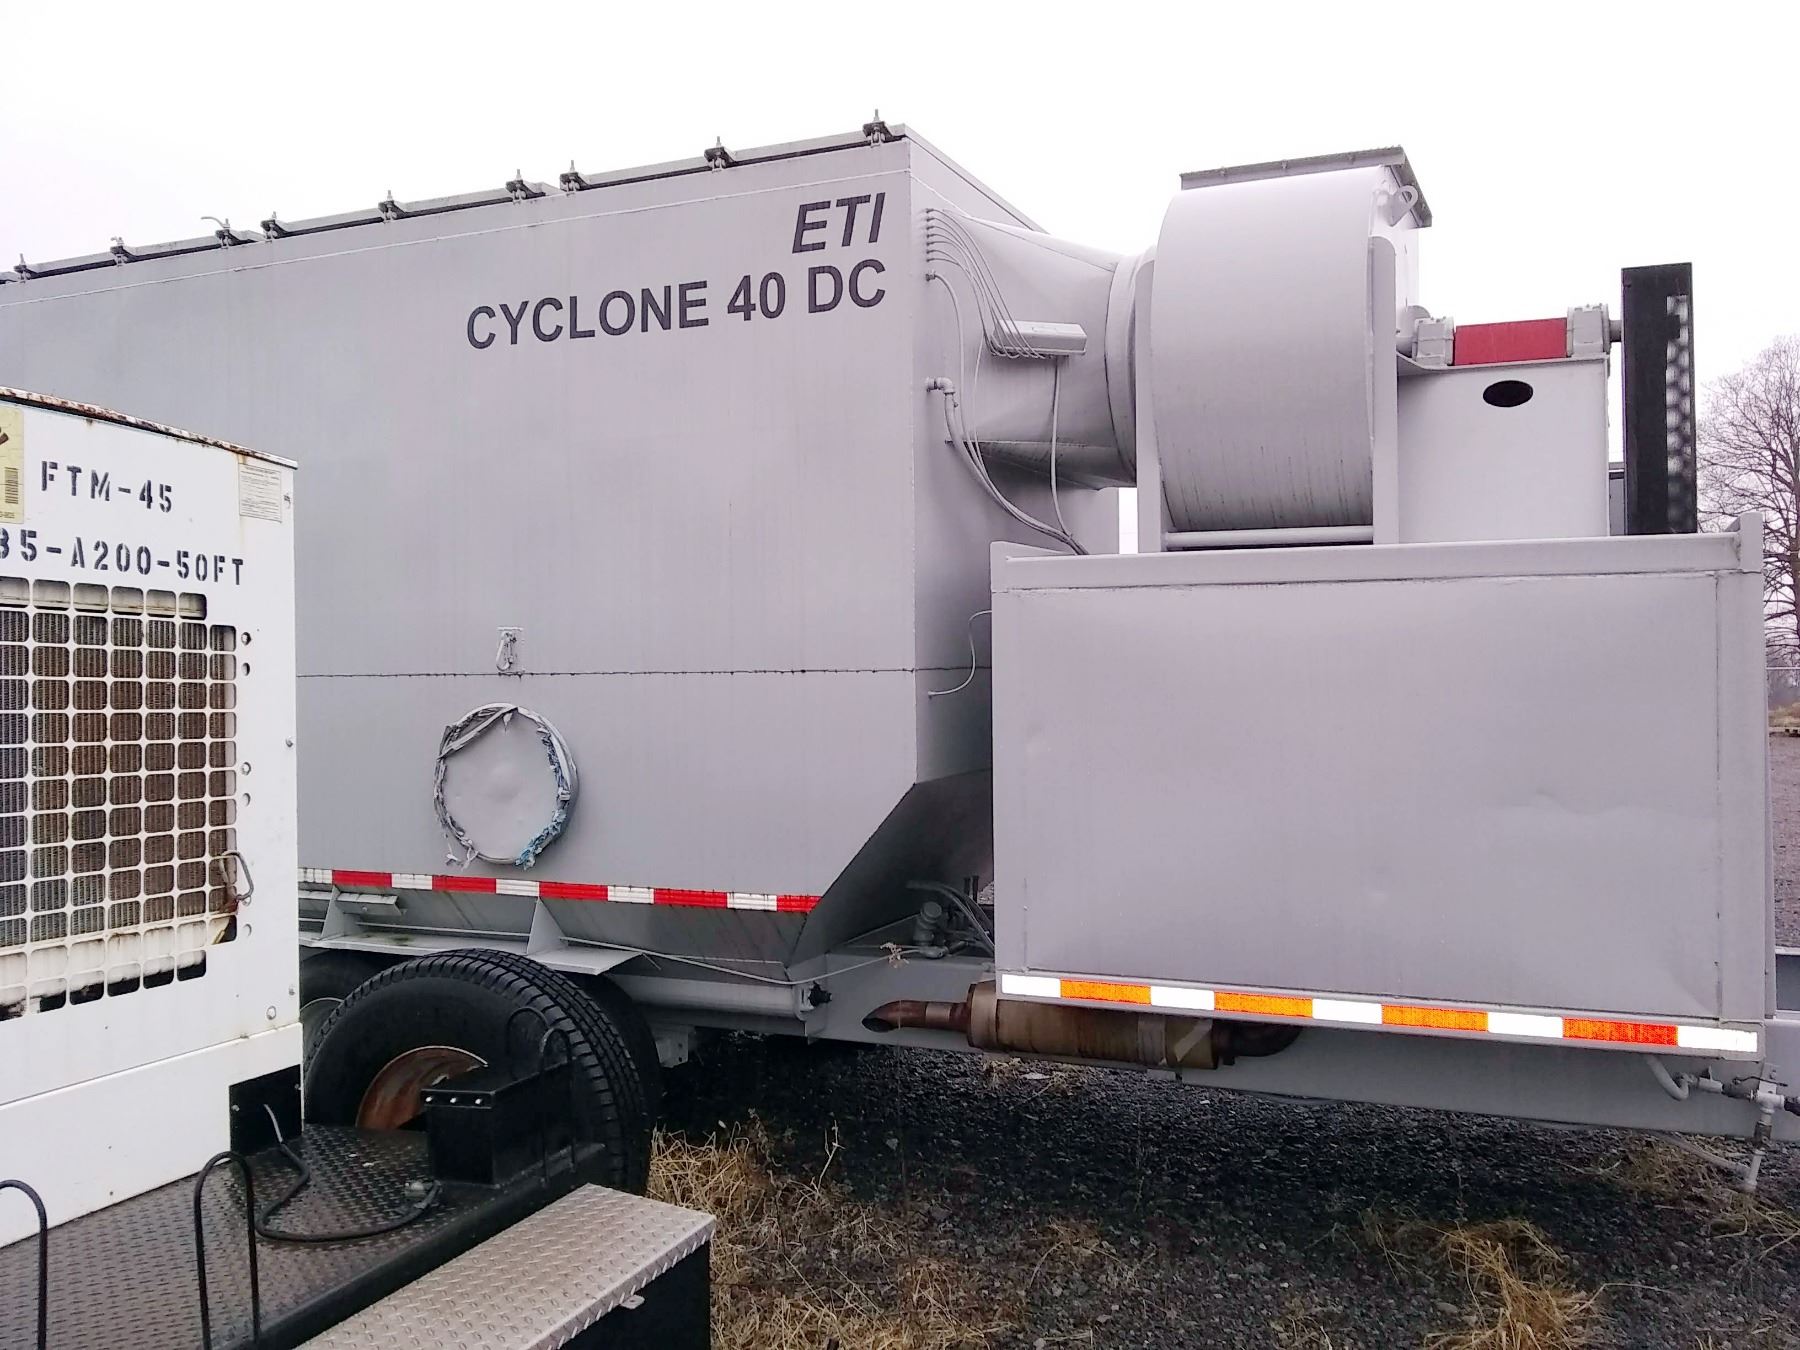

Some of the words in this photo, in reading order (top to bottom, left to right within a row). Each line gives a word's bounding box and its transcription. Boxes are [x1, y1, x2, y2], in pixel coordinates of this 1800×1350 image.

[791, 192, 886, 254] ETI
[466, 280, 709, 349] CYCLONE
[726, 271, 786, 321] 40
[807, 258, 886, 314] DC
[41, 460, 173, 513] FTM-45
